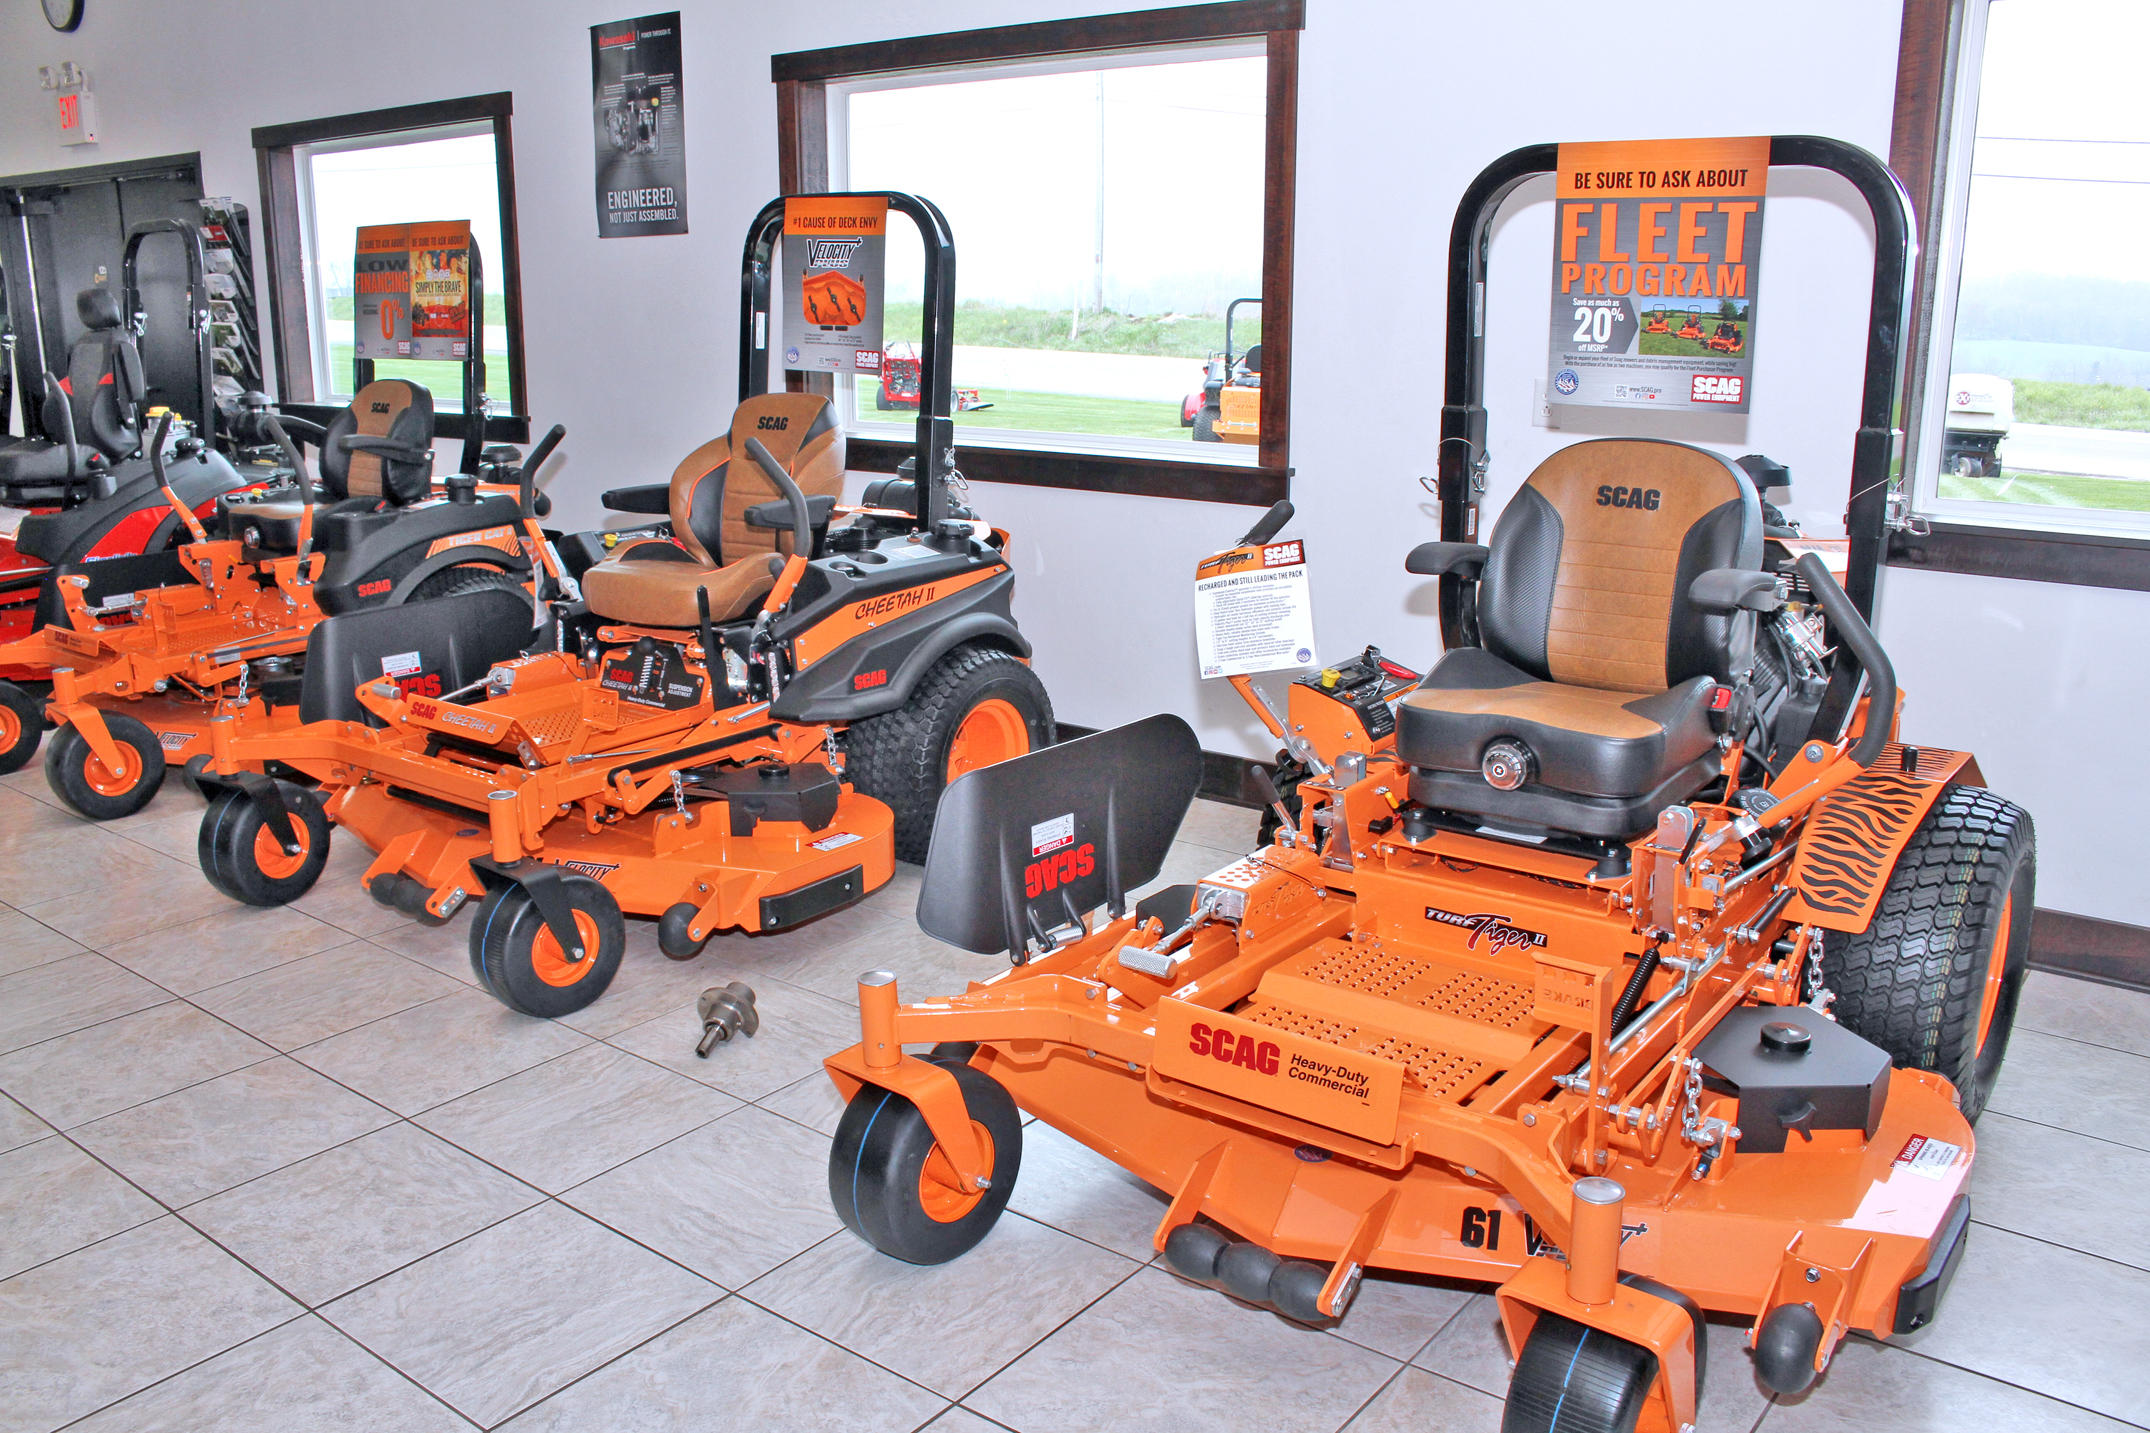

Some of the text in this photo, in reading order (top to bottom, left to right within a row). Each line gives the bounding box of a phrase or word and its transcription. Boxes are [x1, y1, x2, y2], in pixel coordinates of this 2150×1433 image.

[58, 94, 79, 130] EXIT
[1574, 169, 1748, 189] BE SURE TO ASK ABOUT
[608, 187, 678, 209] ENGINEERED,
[609, 208, 679, 224] NOT JUST ASSEMBLED.
[793, 216, 878, 228] #1 CAUSE OF DECK ENVY
[1560, 202, 1758, 263] FLEET
[356, 260, 409, 272] LOW
[355, 271, 409, 294] FINANCING
[416, 280, 461, 294] SIMPLY THE BRAVE
[1561, 262, 1747, 297] PROGRAM
[1572, 298, 1587, 306] Save
[1595, 298, 1612, 306] much
[381, 299, 404, 340] 0%
[1573, 306, 1624, 343] 20%
[856, 352, 879, 364] SCAG
[1693, 376, 1741, 394] SCAG
[757, 416, 788, 430] SCAG
[1596, 485, 1661, 511] SCAG
[1264, 544, 1300, 560] SCAG
[358, 579, 392, 597] SCAG
[1198, 580, 1228, 592] RECHARGED
[1240, 577, 1254, 585] STILL
[1254, 574, 1278, 584] LEADING
[1278, 572, 1288, 580] THE
[1289, 570, 1303, 578] PACK
[855, 586, 936, 620] CHEETAH II
[602, 680, 628, 690] CHEETAH
[610, 668, 634, 683] SCAG
[854, 669, 887, 690] SCAG
[394, 674, 442, 704] SCA
[410, 702, 437, 720] SCAG
[442, 711, 488, 732] CHEETAH
[1024, 842, 1095, 899] SCAG
[1426, 908, 1546, 956] TURF Tiger II
[1189, 1022, 1280, 1076] SCAG
[1290, 1053, 1368, 1087] Heavy-Duty
[1288, 1066, 1370, 1099] Commercial
[1460, 1206, 1501, 1251] 61
